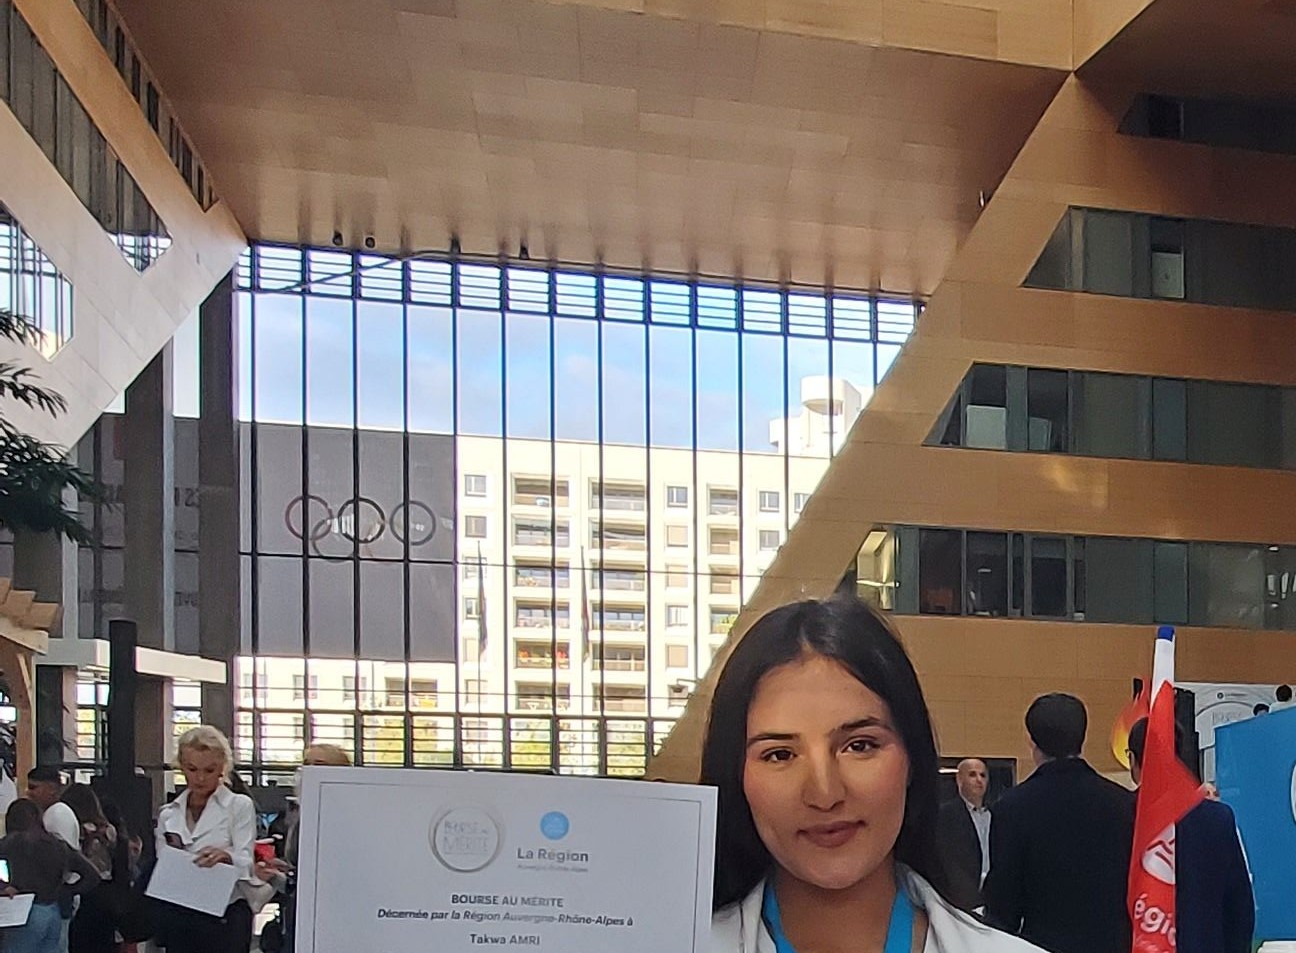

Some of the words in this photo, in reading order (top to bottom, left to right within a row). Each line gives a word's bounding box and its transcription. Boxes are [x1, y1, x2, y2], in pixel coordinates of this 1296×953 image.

[517, 847, 534, 860] La
[451, 894, 499, 905] BOURSE
[501, 896, 518, 906] AU
[431, 911, 449, 922] par
[451, 910, 461, 920] la
[463, 910, 500, 923] Région
[626, 916, 633, 926] à
[470, 934, 506, 945] Takwa
[509, 935, 540, 946] AMRI
